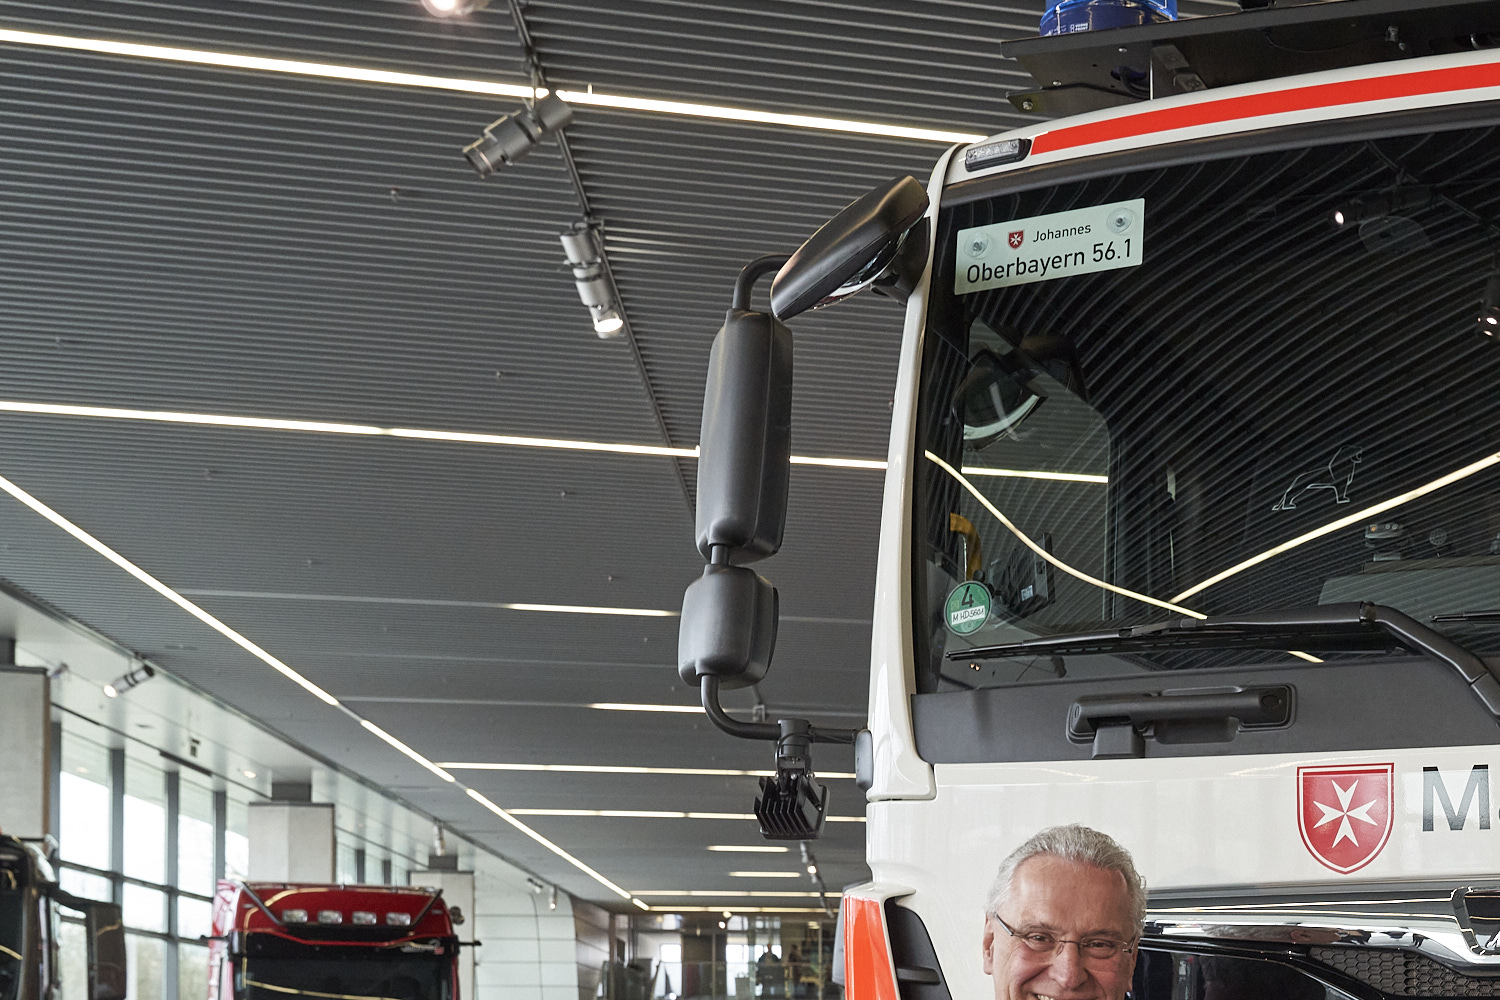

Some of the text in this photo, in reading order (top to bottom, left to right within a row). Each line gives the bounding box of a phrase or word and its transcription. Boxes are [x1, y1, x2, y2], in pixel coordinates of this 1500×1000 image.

[1033, 224, 1091, 242] Johannes
[967, 238, 1131, 284] Oberbayern 56.1
[961, 585, 974, 607] 4
